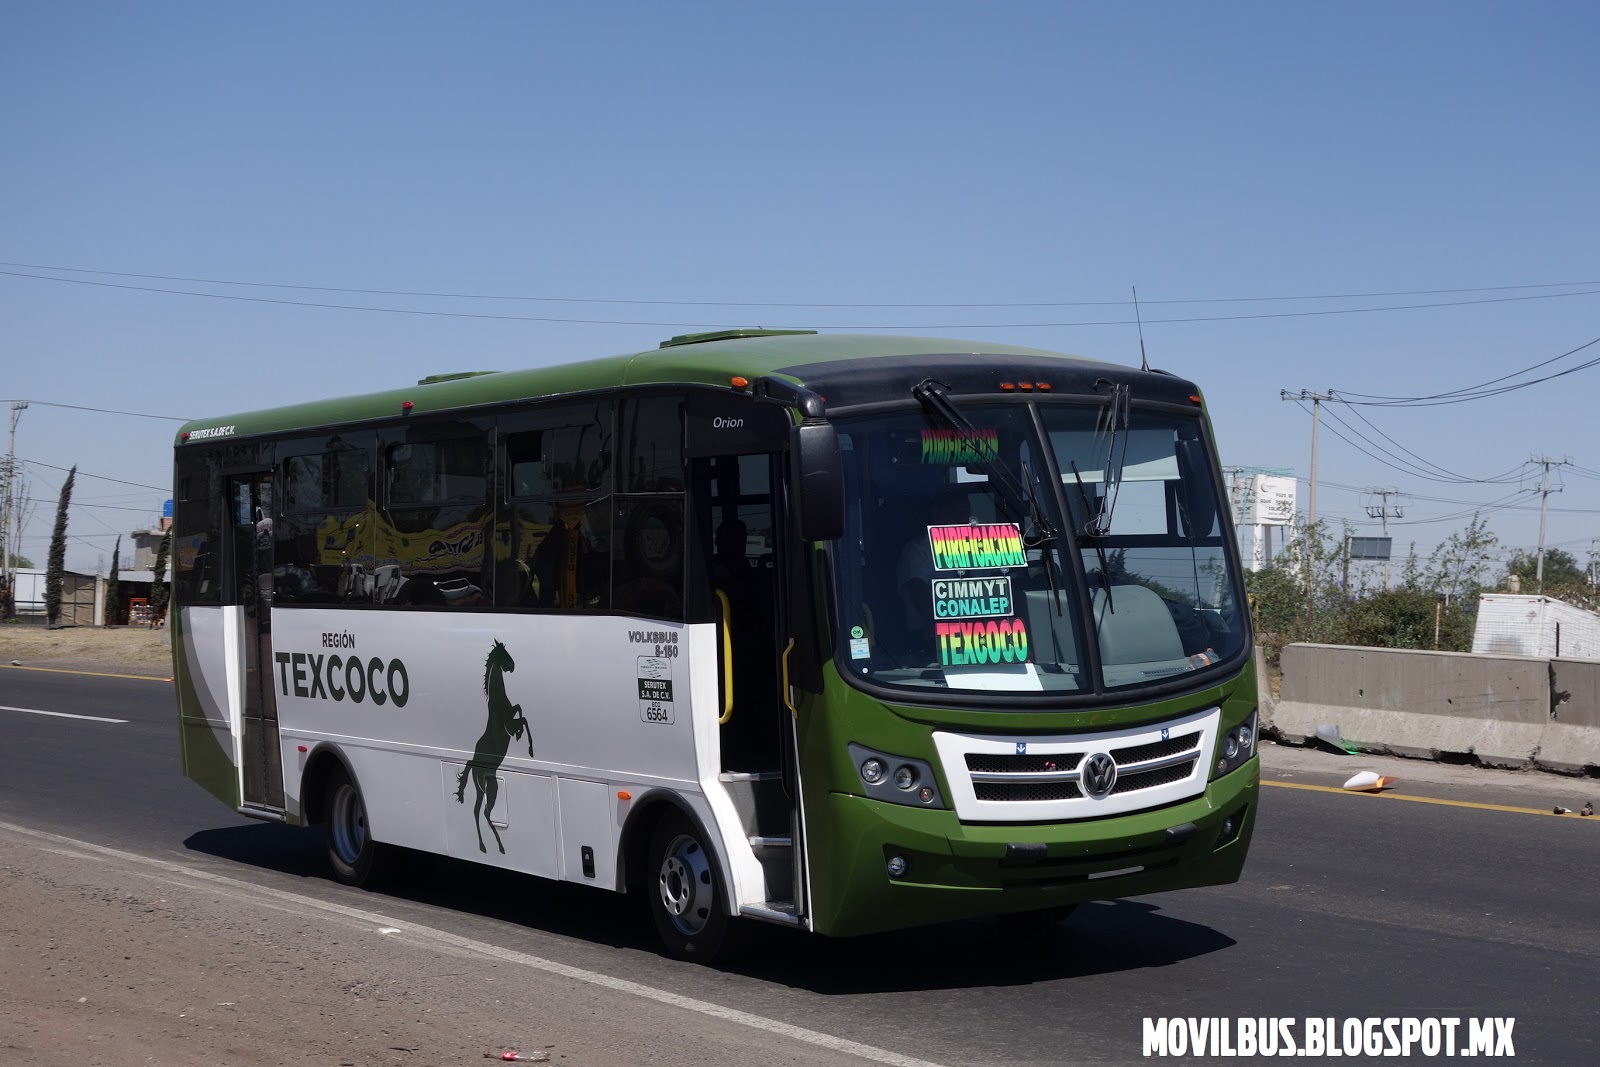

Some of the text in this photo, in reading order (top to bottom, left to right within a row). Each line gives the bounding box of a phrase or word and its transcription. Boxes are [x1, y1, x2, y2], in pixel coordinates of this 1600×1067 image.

[713, 416, 744, 428] Orion
[189, 429, 211, 440] SERUTEX
[930, 525, 1025, 569] PURIFICACION
[935, 580, 1007, 599] CIMMYT
[936, 597, 1009, 617] CONALEP
[322, 629, 355, 648] REGIÓN
[628, 631, 678, 644] VOLKSBUS
[936, 618, 1028, 666] TEXCOCO
[655, 644, 679, 658] 8-150
[275, 652, 409, 708] TEXCOCO
[644, 680, 667, 690] SERUTEX
[641, 690, 671, 700] S.A. DE C.V.
[646, 707, 668, 722] 6564
